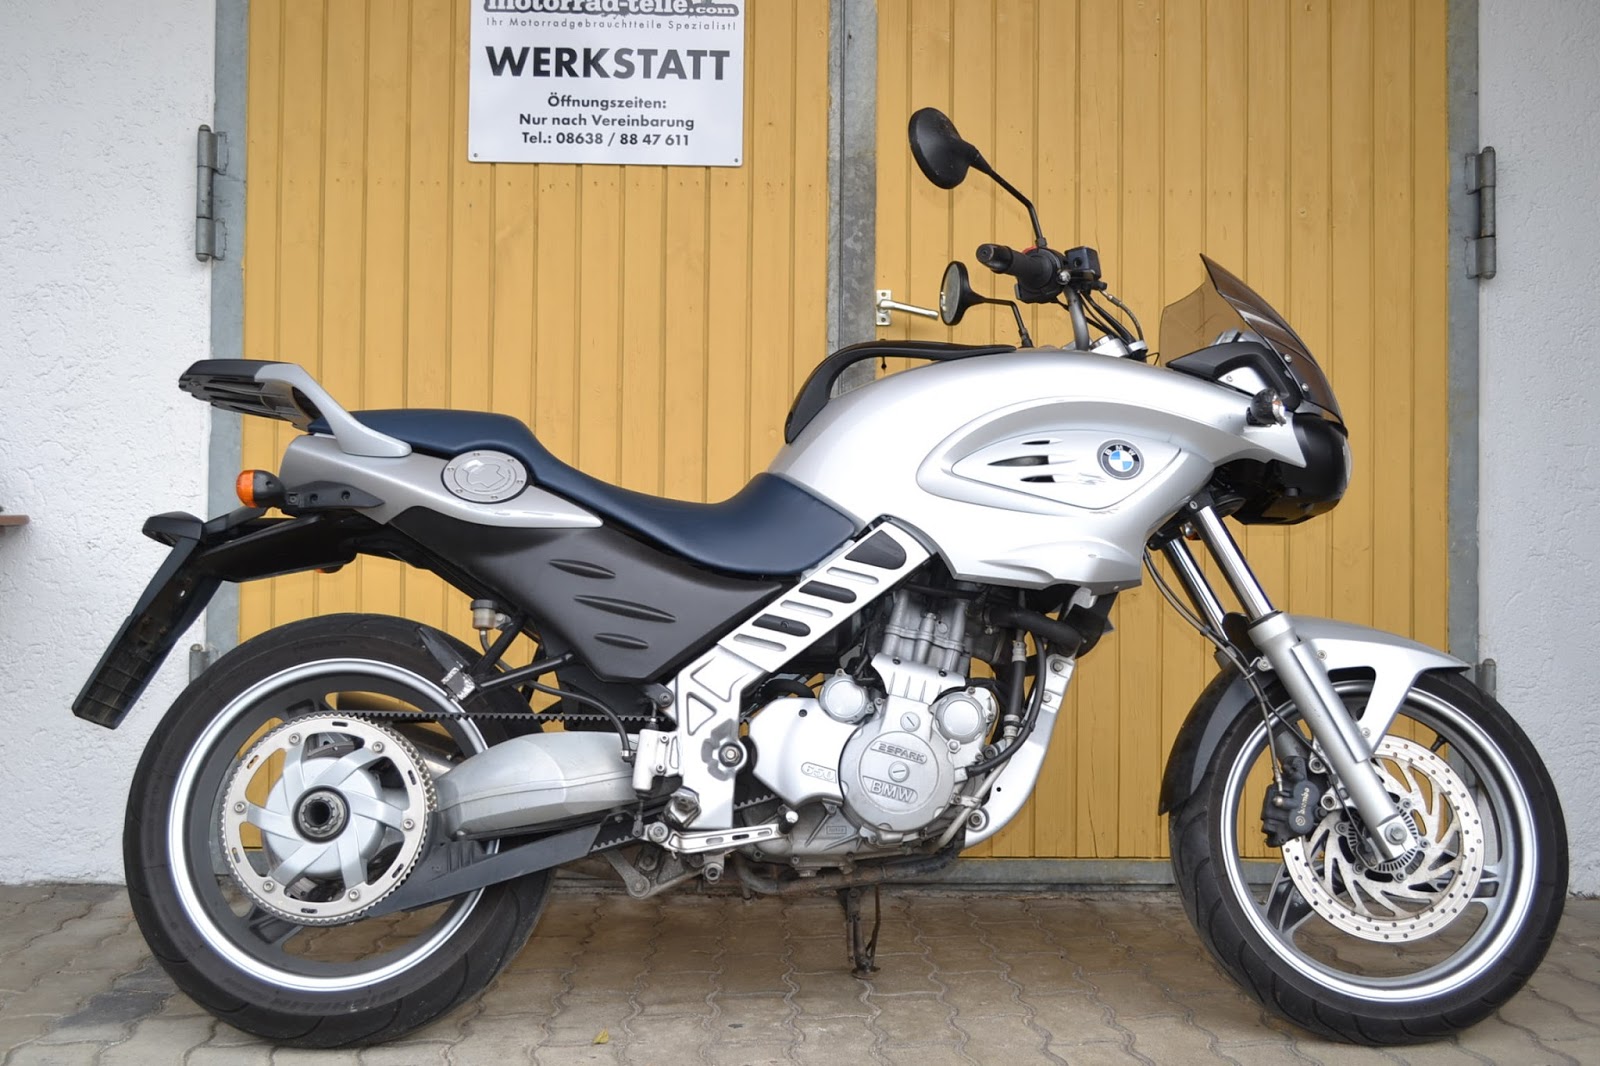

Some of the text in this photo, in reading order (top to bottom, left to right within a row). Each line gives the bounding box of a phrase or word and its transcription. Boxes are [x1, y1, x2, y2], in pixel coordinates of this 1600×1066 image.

[486, 17, 503, 26] Ihr
[509, 17, 662, 30] Motorradgebrauchtteile
[485, 46, 730, 81] WERKSTATT
[547, 92, 667, 111] Öffnungszeiten:
[519, 113, 695, 131] Nur nach Vereinbarung
[521, 131, 689, 147] Tel.: 08638 / 88 47 611
[878, 743, 925, 762] 2SPARK
[871, 779, 914, 803] BMW
